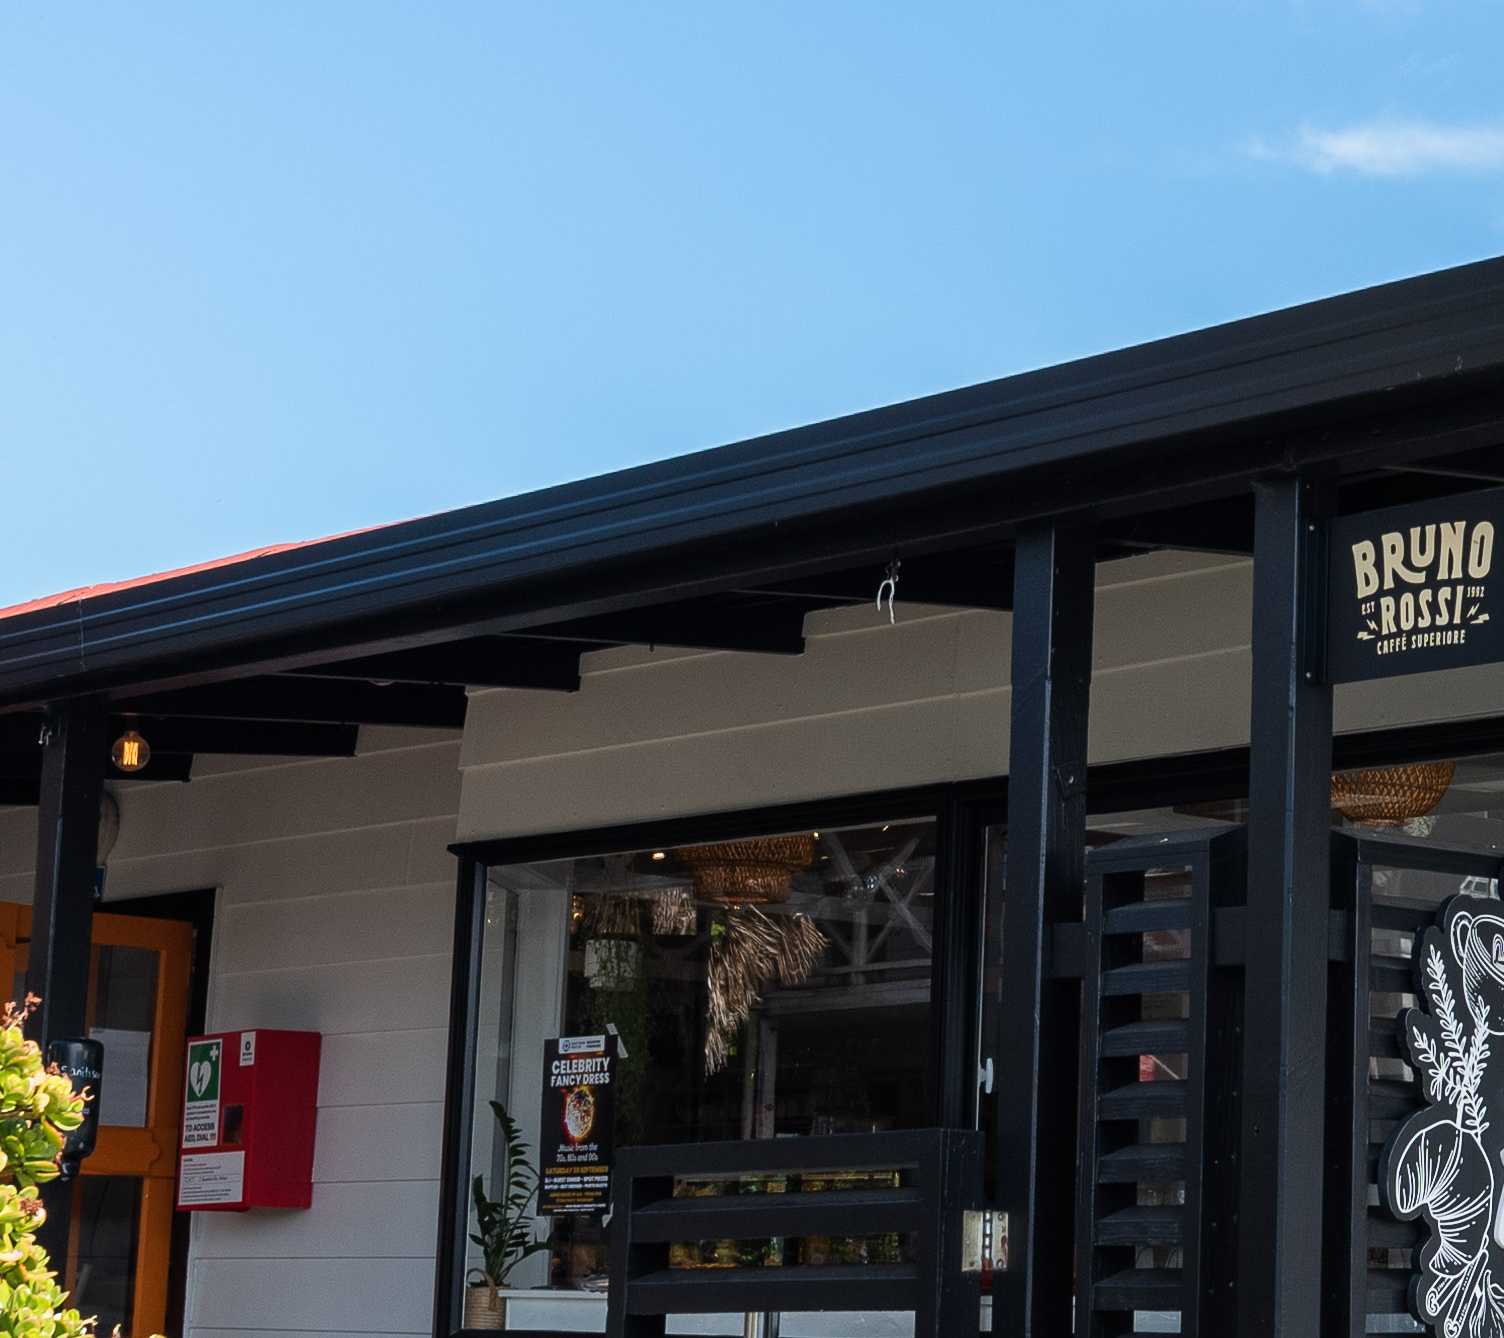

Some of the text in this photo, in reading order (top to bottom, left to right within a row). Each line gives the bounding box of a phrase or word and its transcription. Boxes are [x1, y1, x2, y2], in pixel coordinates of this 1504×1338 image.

[1352, 521, 1494, 599] BRUNO
[1467, 586, 1485, 598] 1992
[1361, 601, 1375, 615] EST
[1380, 585, 1464, 635] ROSSI
[1411, 629, 1466, 648] SUPERIORE
[551, 1057, 610, 1074] CELEBRITY
[550, 1072, 610, 1087] FANCY DRESS
[193, 1122, 215, 1132] ACCESS
[196, 1133, 209, 1142] DIAL
